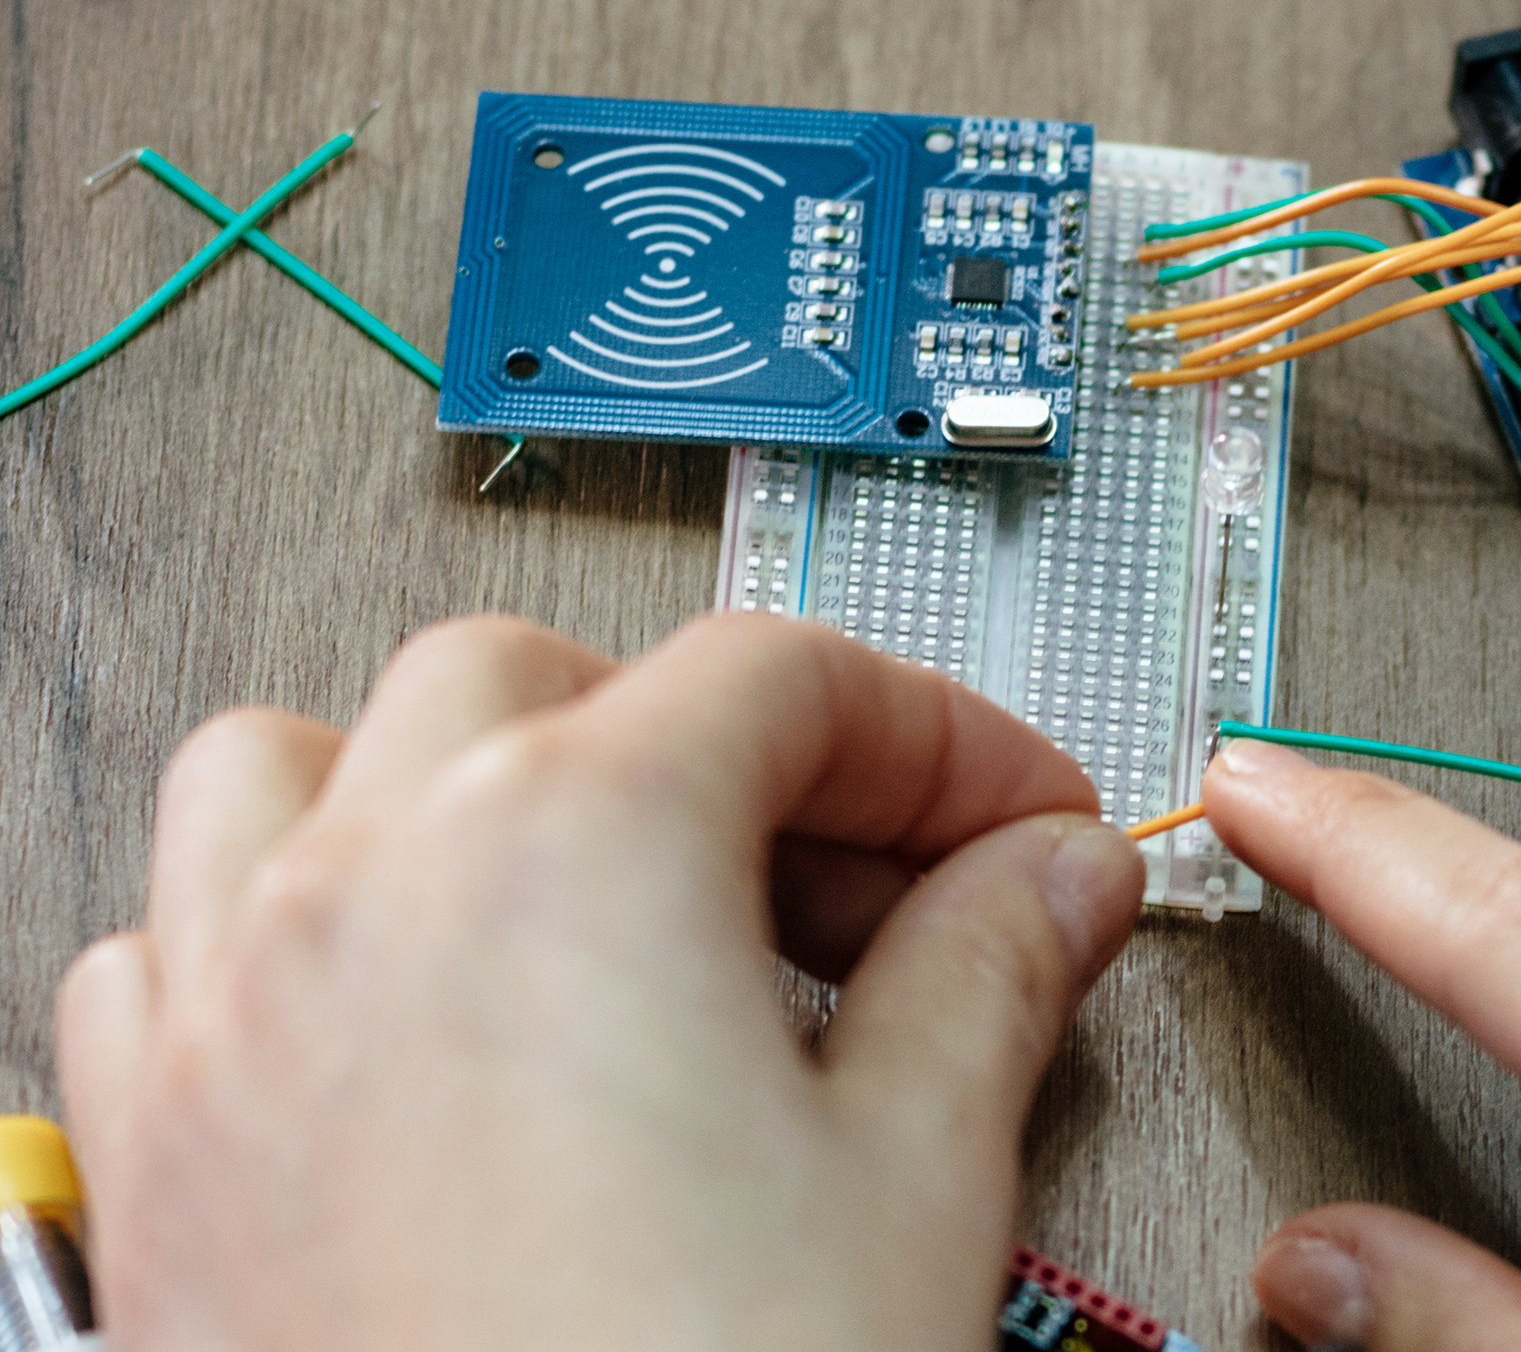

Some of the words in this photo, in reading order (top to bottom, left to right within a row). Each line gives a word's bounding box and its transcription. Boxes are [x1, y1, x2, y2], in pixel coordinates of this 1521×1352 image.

[916, 366, 938, 379] C2
[946, 367, 967, 381] R4
[972, 368, 994, 382] R3
[1000, 369, 1022, 382] C3
[933, 381, 949, 408] C12
[1056, 387, 1072, 414] C13
[1173, 453, 1188, 465] 14
[1172, 475, 1187, 487] 15
[833, 485, 849, 497] 17
[1170, 497, 1186, 509] 16
[832, 507, 847, 519] 18
[1168, 519, 1184, 531] 17
[829, 530, 845, 542] 19
[1167, 541, 1182, 553] 18
[826, 552, 844, 564] 20
[1164, 562, 1180, 575] 19
[823, 574, 840, 586] 21
[1163, 585, 1180, 597] 20
[821, 597, 839, 609] 22
[1160, 607, 1176, 620] 21
[1158, 629, 1176, 642] 22
[1156, 652, 1174, 665] 23
[1155, 674, 1172, 687] 24
[1153, 696, 1170, 709] 25
[1152, 719, 1170, 732] 26
[1150, 741, 1167, 755] 27
[1148, 765, 1166, 778] 28
[1146, 787, 1164, 801] 29
